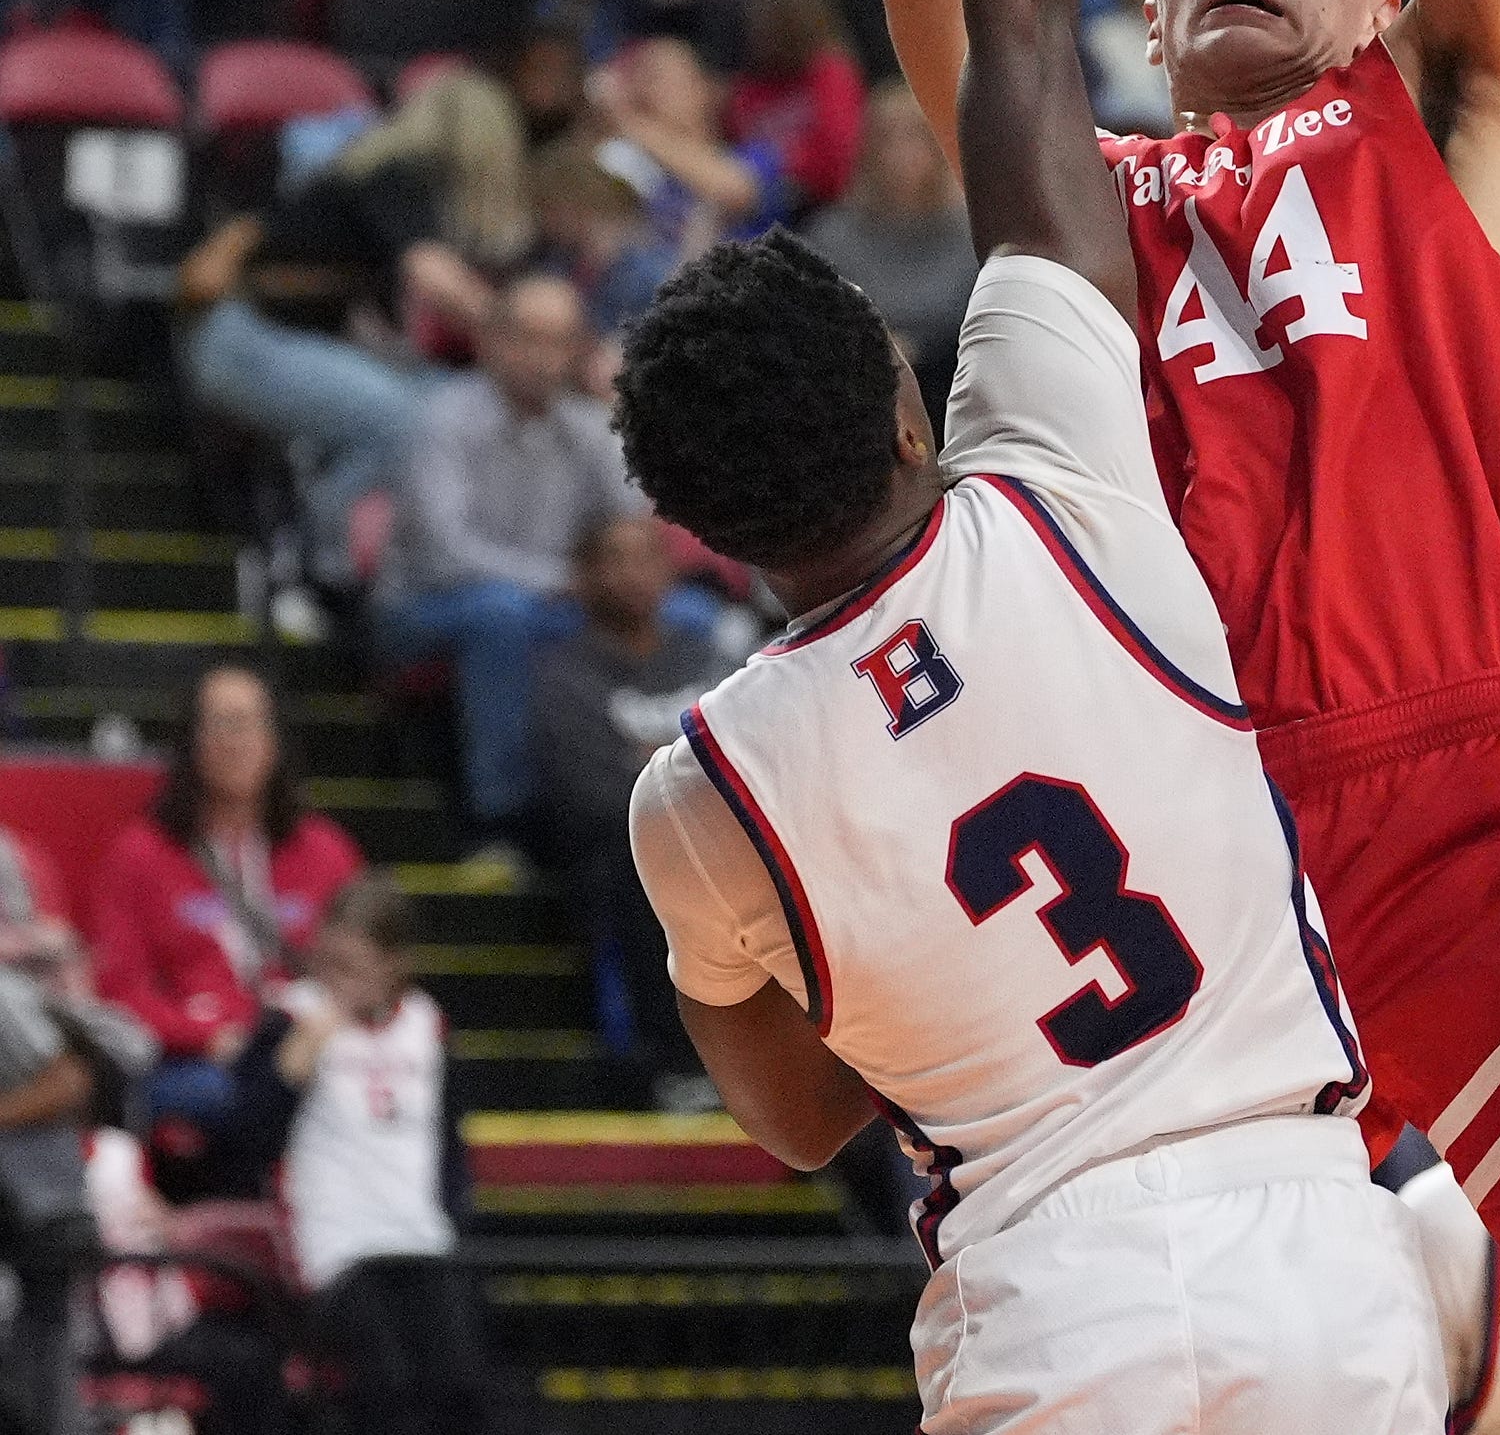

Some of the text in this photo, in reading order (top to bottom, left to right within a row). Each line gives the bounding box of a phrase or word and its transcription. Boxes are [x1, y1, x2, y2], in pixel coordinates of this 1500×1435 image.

[1256, 98, 1353, 156] Zee
[1157, 163, 1368, 385] 44
[850, 618, 964, 741] B
[944, 771, 1204, 1068] 3
